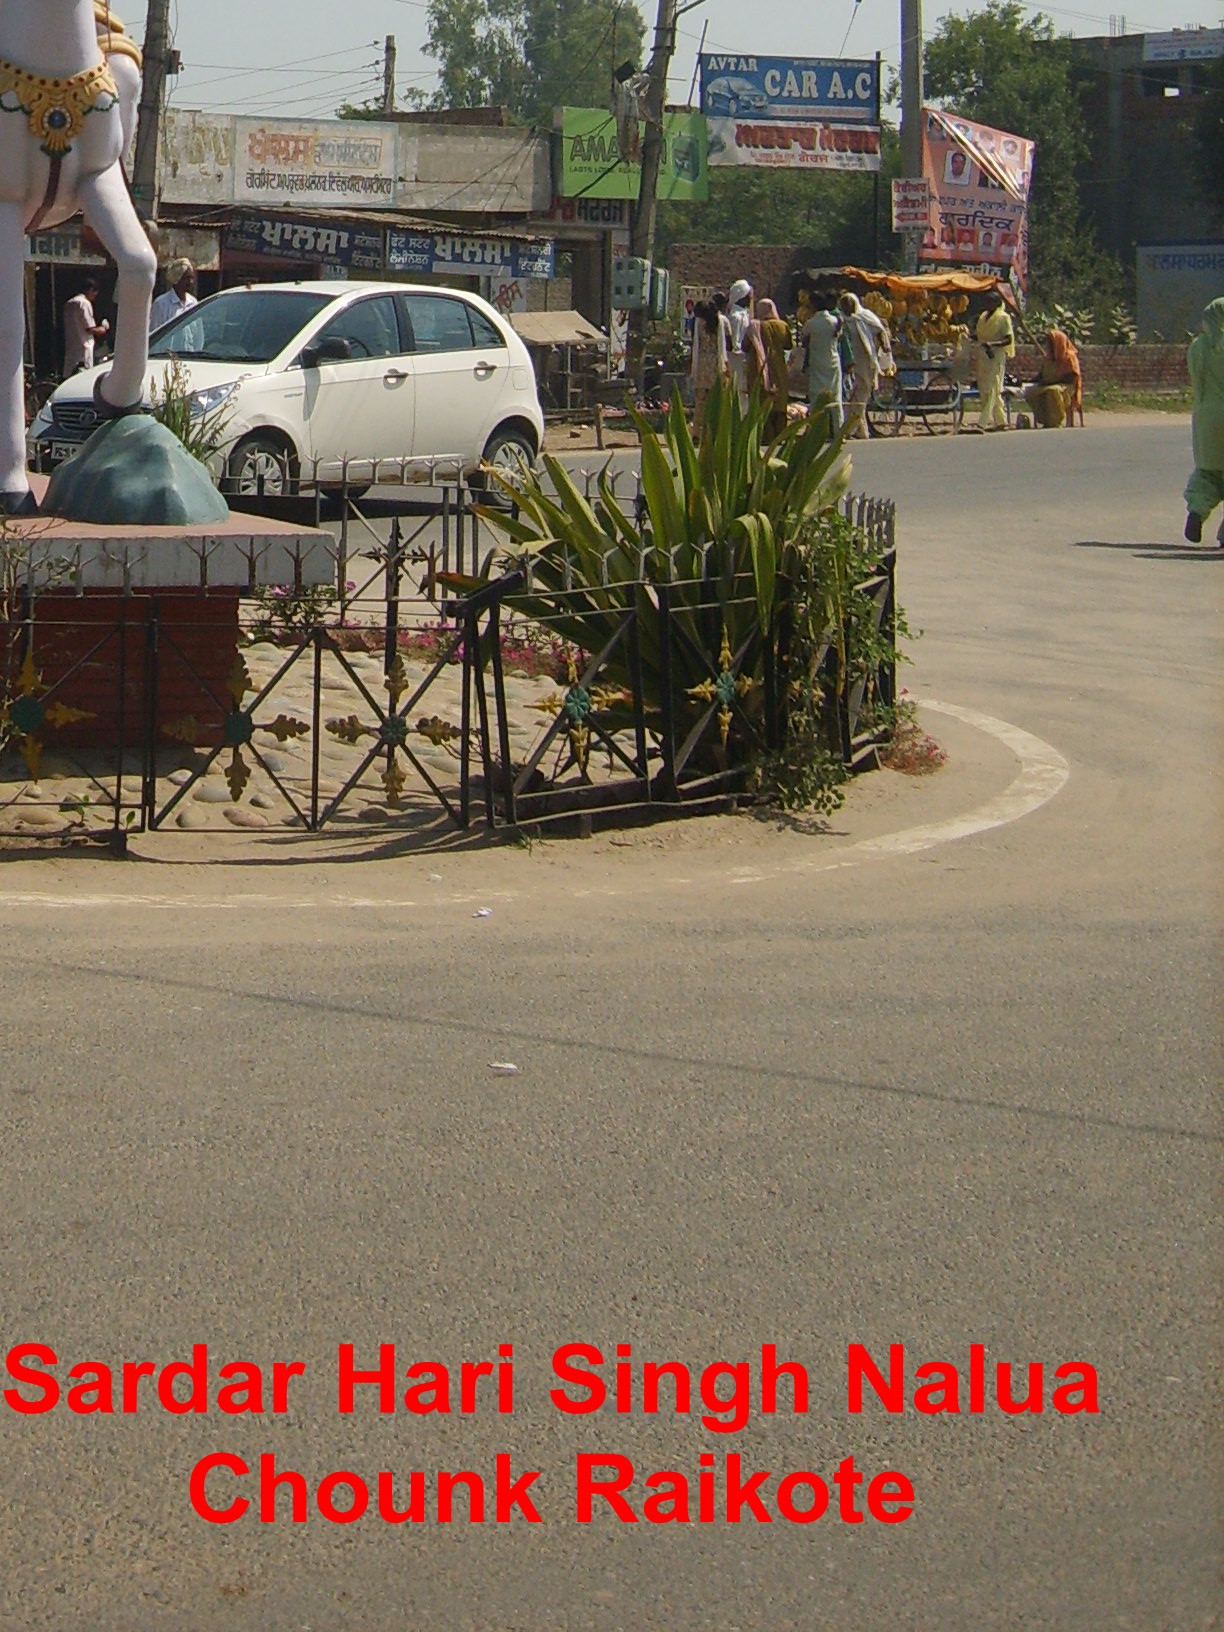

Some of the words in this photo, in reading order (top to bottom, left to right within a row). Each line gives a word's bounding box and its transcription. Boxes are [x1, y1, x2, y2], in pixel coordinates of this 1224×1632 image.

[707, 56, 759, 72] AVTAR
[764, 69, 819, 99] CAR
[827, 71, 872, 100] A.C
[570, 134, 667, 165] AMA
[262, 219, 349, 255] ਖਾਲਸਾ
[434, 235, 512, 265] ਖਾਲਸਾ
